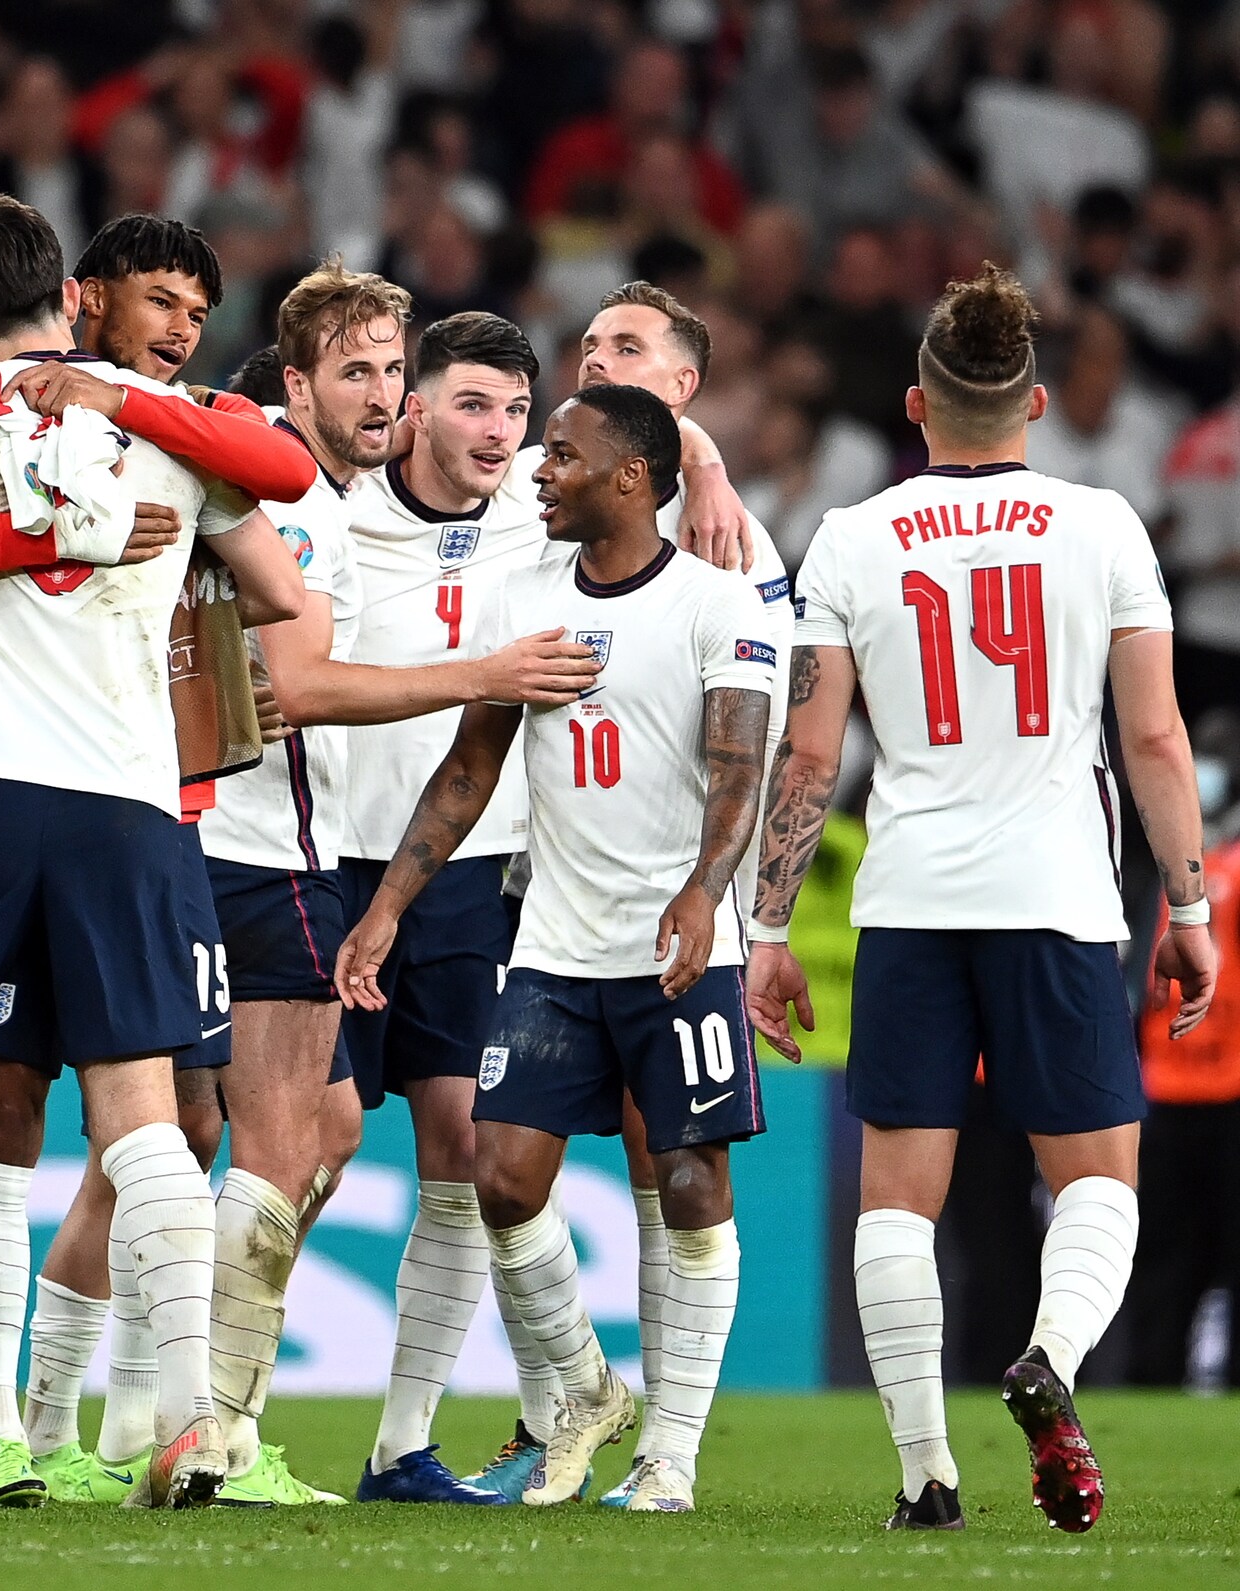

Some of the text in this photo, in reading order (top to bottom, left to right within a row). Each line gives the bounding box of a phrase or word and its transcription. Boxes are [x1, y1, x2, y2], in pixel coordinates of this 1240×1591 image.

[891, 500, 1053, 551] PHILLIPS
[178, 566, 236, 611] AME
[435, 585, 463, 649] 4
[752, 646, 776, 662] RESPEC
[901, 563, 1049, 746] 14
[569, 718, 621, 788] 10
[193, 942, 230, 1014] 15
[672, 1012, 735, 1087] 10
